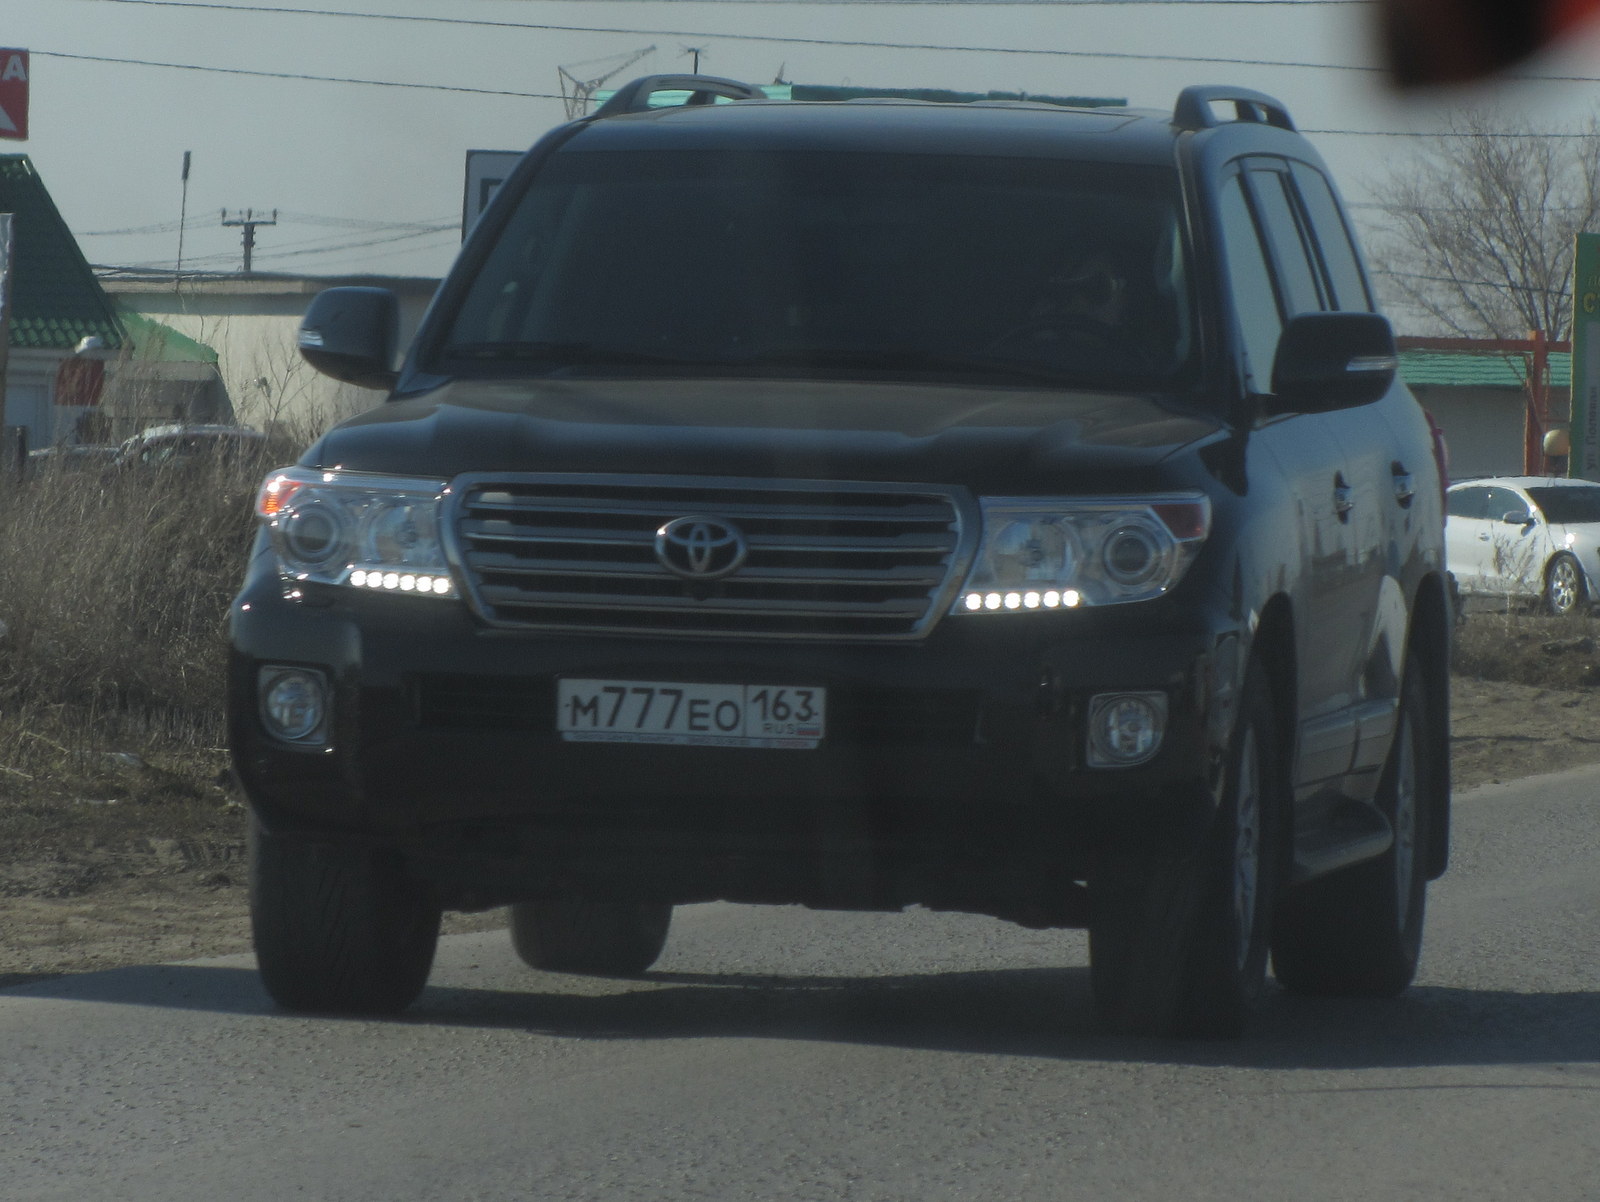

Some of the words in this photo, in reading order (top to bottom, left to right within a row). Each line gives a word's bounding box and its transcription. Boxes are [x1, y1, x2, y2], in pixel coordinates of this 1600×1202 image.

[571, 686, 740, 731] М777ЕО
[752, 690, 814, 721] 163
[763, 723, 794, 735] RUS
